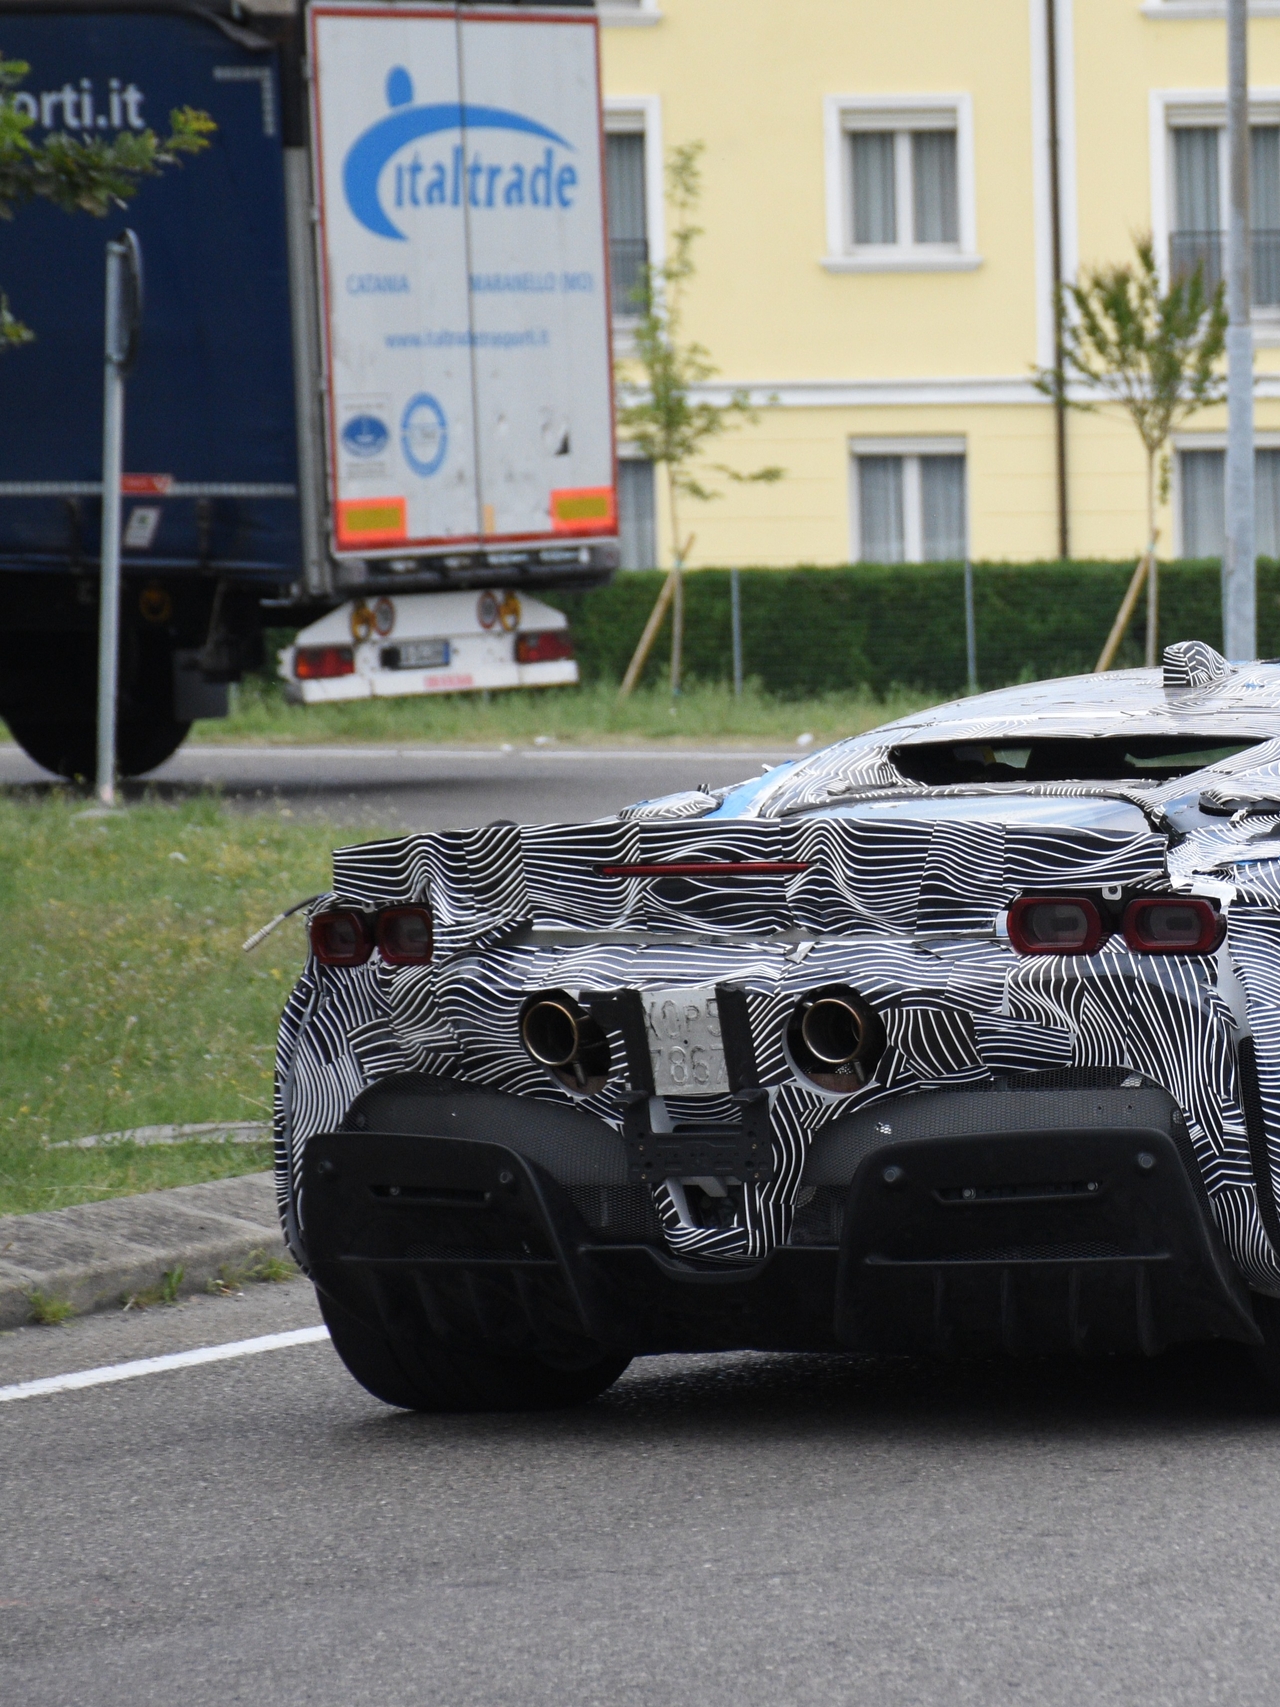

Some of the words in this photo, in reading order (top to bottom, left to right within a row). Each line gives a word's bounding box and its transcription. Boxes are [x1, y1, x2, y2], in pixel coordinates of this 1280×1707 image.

[0, 77, 146, 129] orti.it
[395, 145, 578, 208] italtrade
[347, 273, 410, 294] CATANIA
[470, 271, 555, 292] MARANELLO
